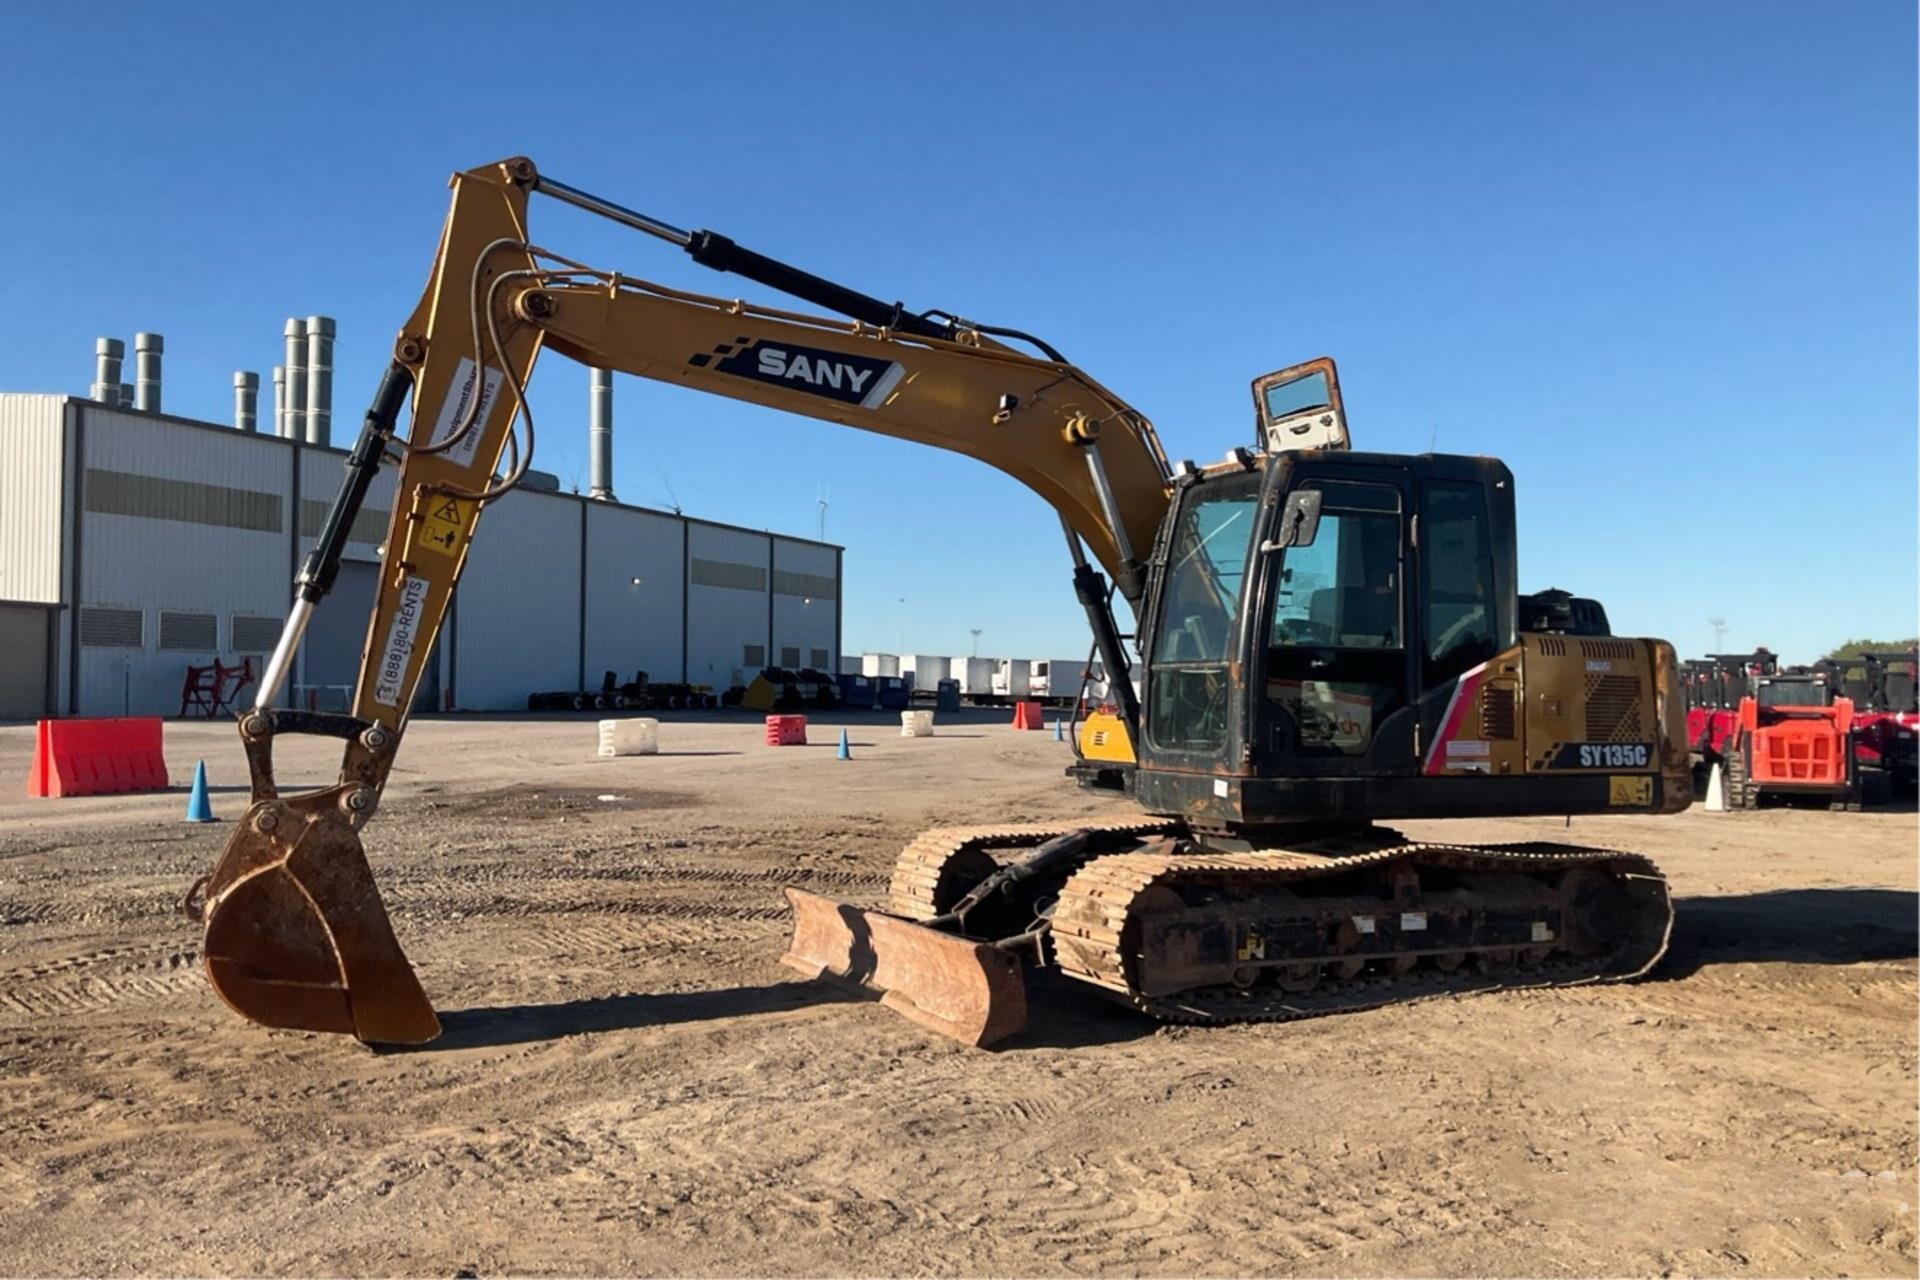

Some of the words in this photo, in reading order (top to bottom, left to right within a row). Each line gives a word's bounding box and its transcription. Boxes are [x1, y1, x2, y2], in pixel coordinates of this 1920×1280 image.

[758, 348, 872, 393] SANY
[383, 580, 422, 684] (888)80-RENTS
[1580, 745, 1647, 767] SY135C
